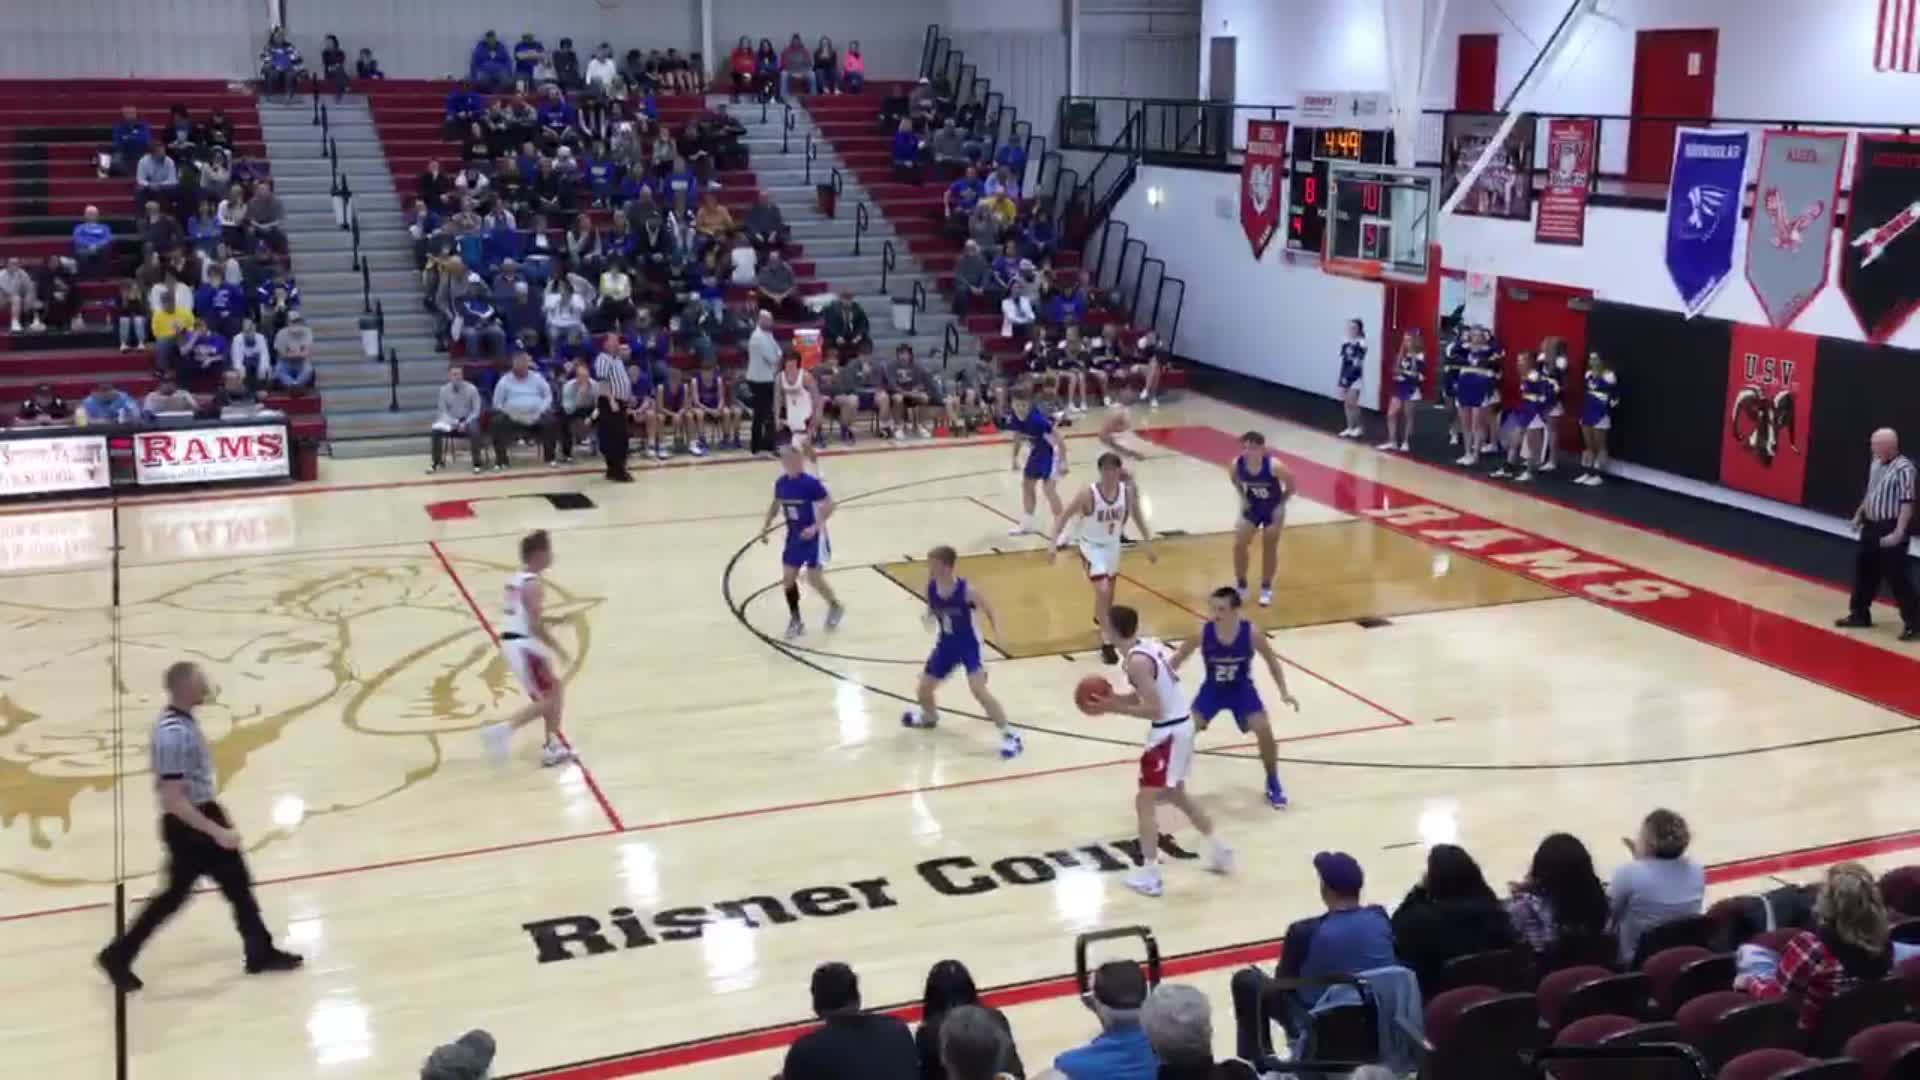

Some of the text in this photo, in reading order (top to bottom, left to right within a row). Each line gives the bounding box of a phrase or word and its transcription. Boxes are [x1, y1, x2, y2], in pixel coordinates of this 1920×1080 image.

[1304, 177, 1317, 204] 8
[140, 432, 284, 467] RAMS
[1359, 503, 1695, 604] RAMS
[522, 876, 899, 964] Risner
